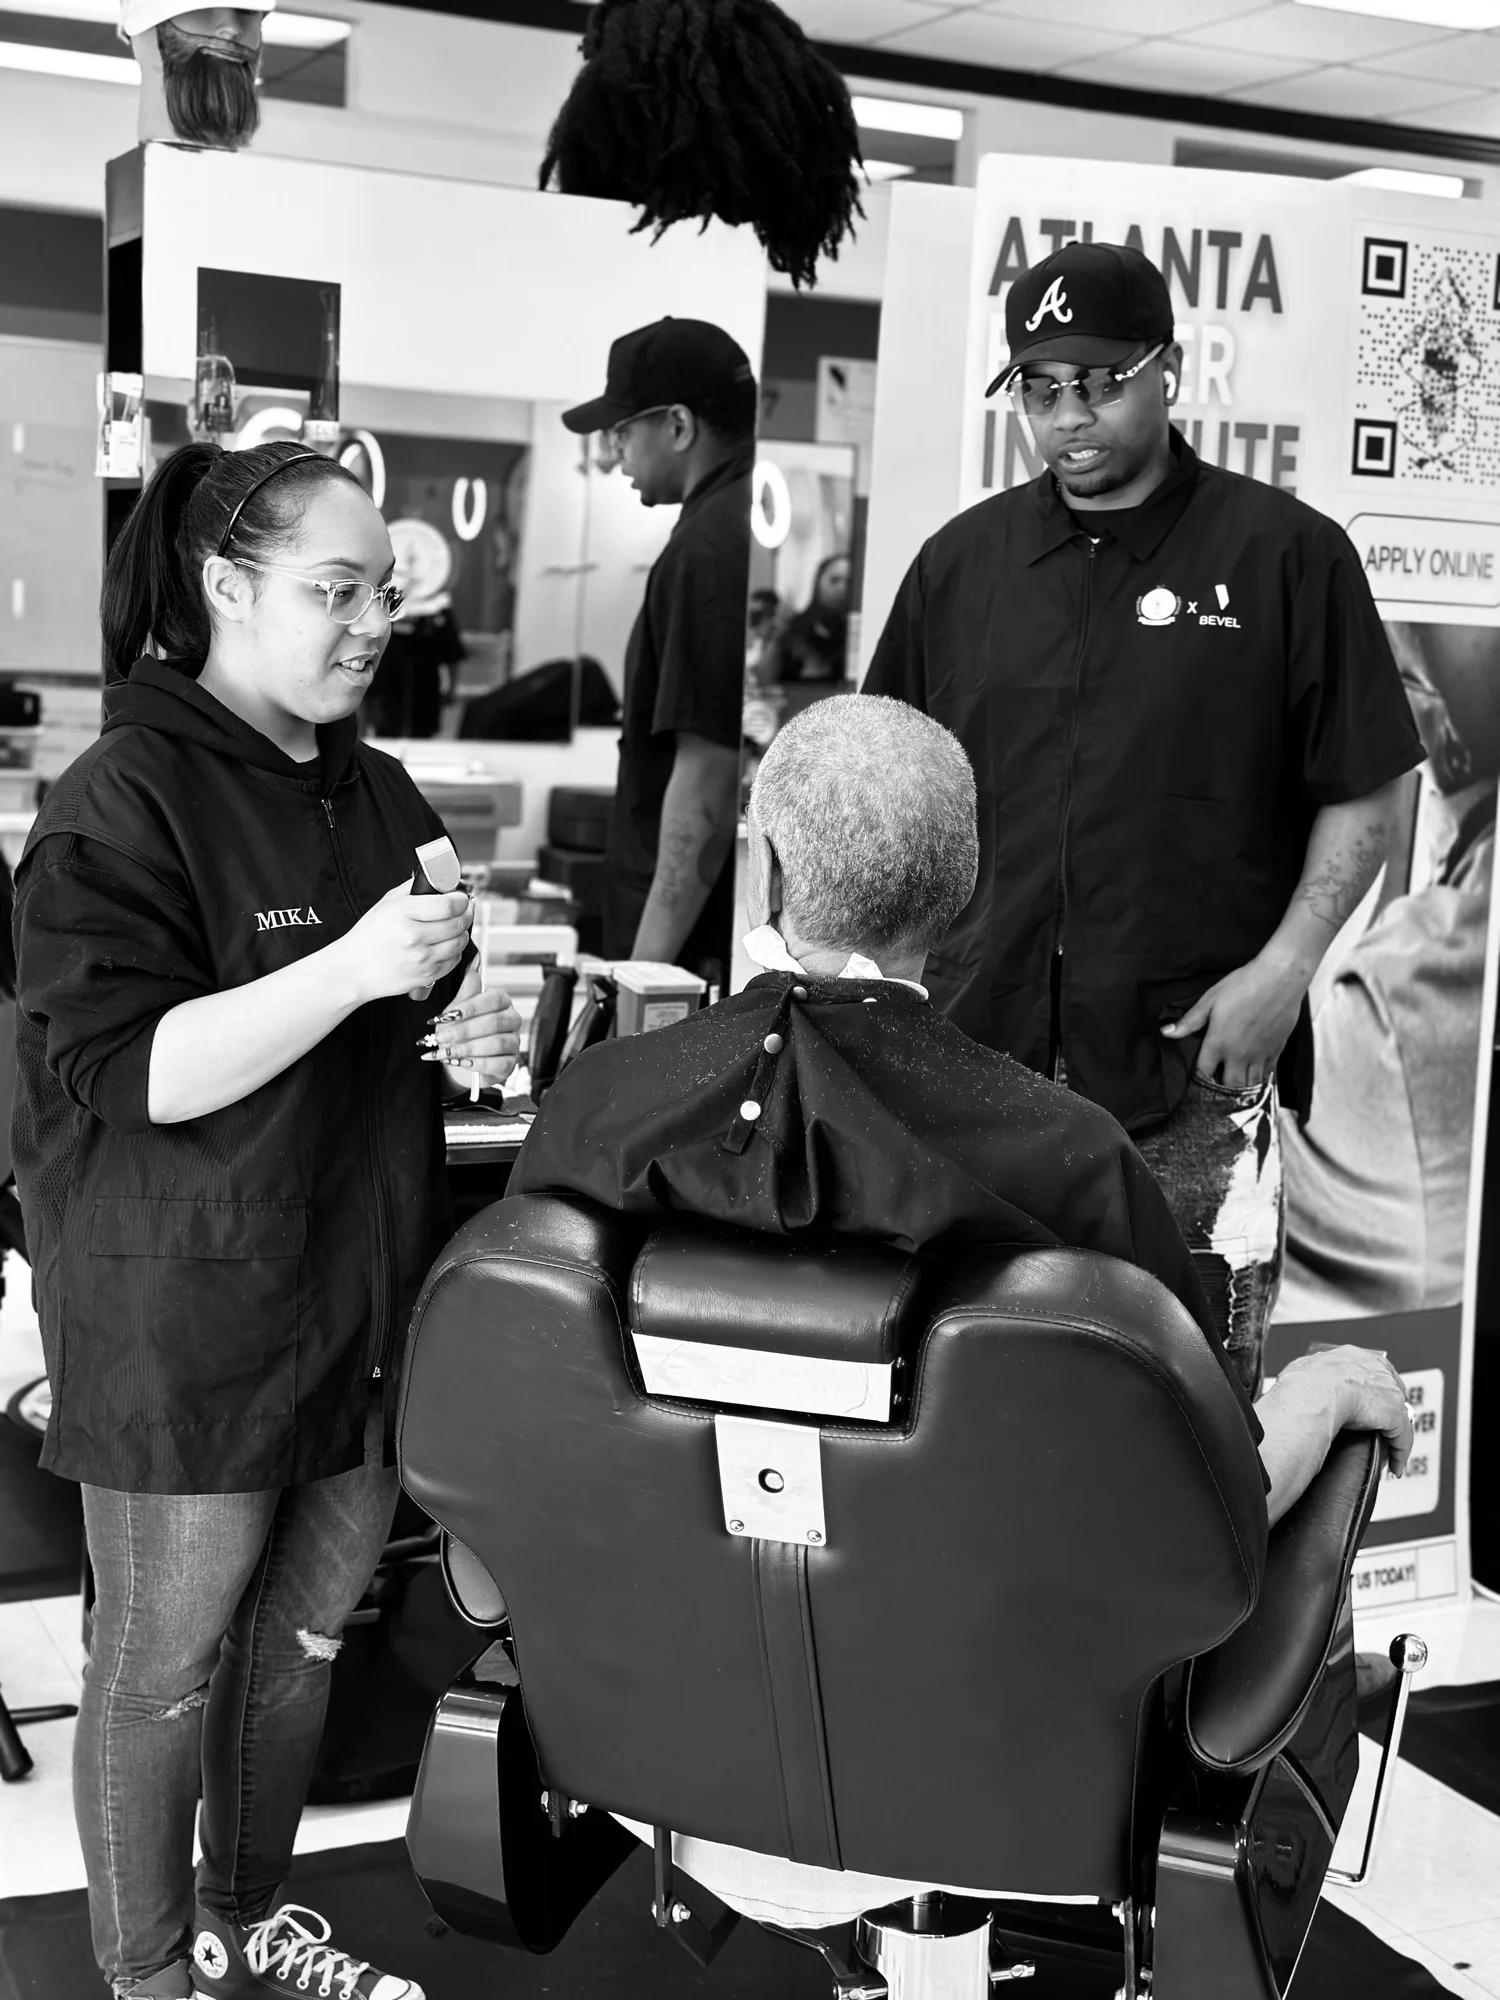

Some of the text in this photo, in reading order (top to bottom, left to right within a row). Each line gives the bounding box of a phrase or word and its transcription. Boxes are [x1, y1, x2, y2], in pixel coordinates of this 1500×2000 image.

[1363, 545, 1494, 579] APPLY ONLINE
[1199, 615, 1241, 628] BEVEL
[254, 906, 323, 931] MIKA
